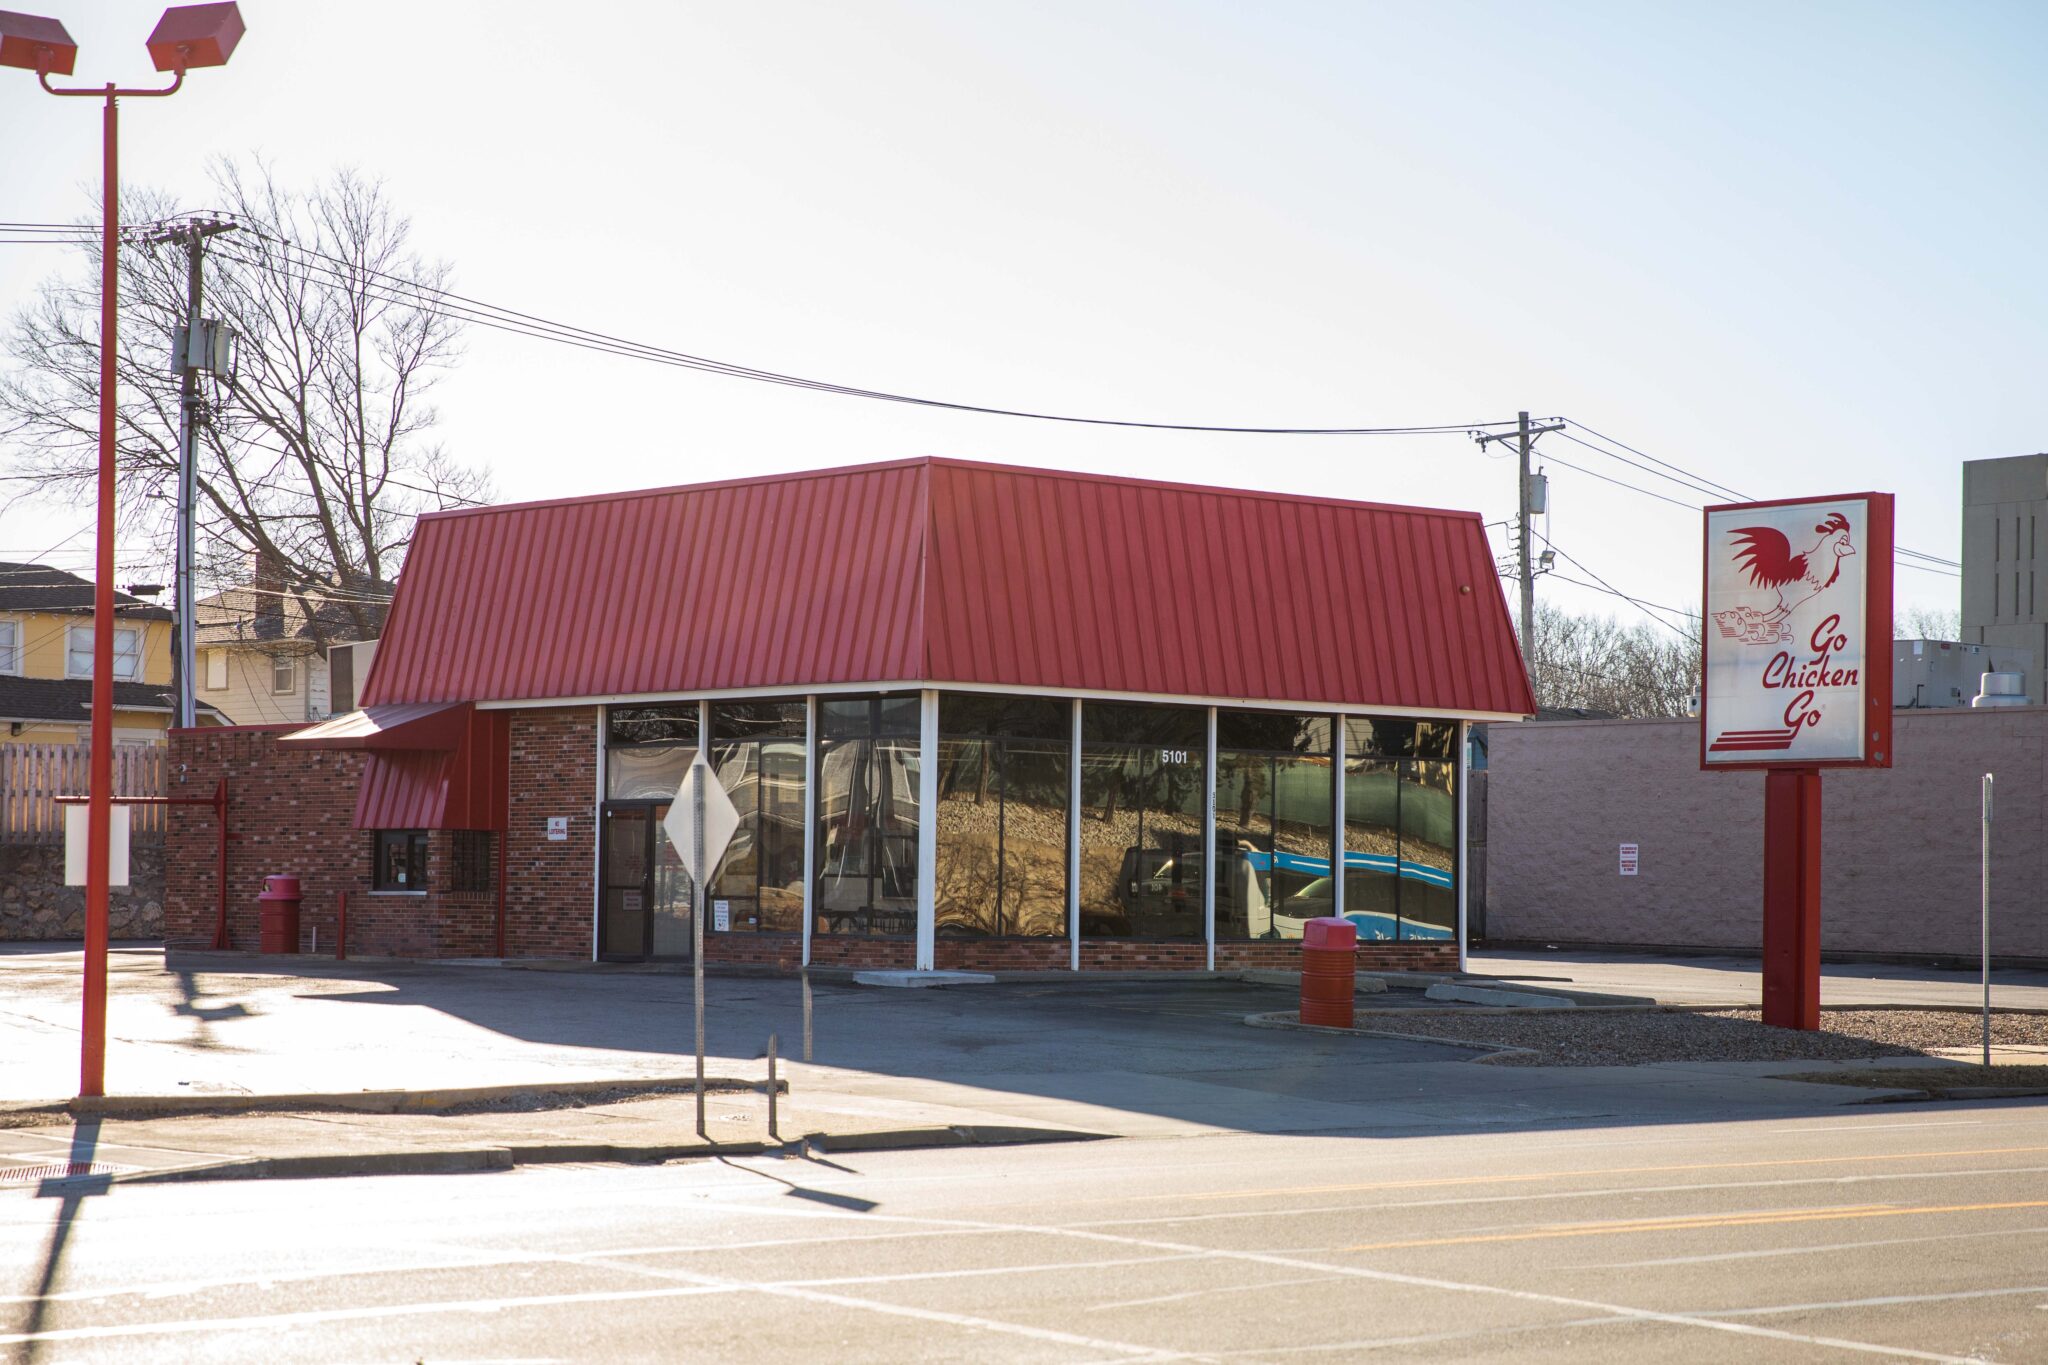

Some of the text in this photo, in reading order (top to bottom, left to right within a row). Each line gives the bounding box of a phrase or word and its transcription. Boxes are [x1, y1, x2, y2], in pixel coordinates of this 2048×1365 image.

[1810, 613, 1847, 666] Go
[1762, 651, 1858, 689] Chicken
[1783, 690, 1821, 740] Go
[1162, 750, 1187, 764] 5101
